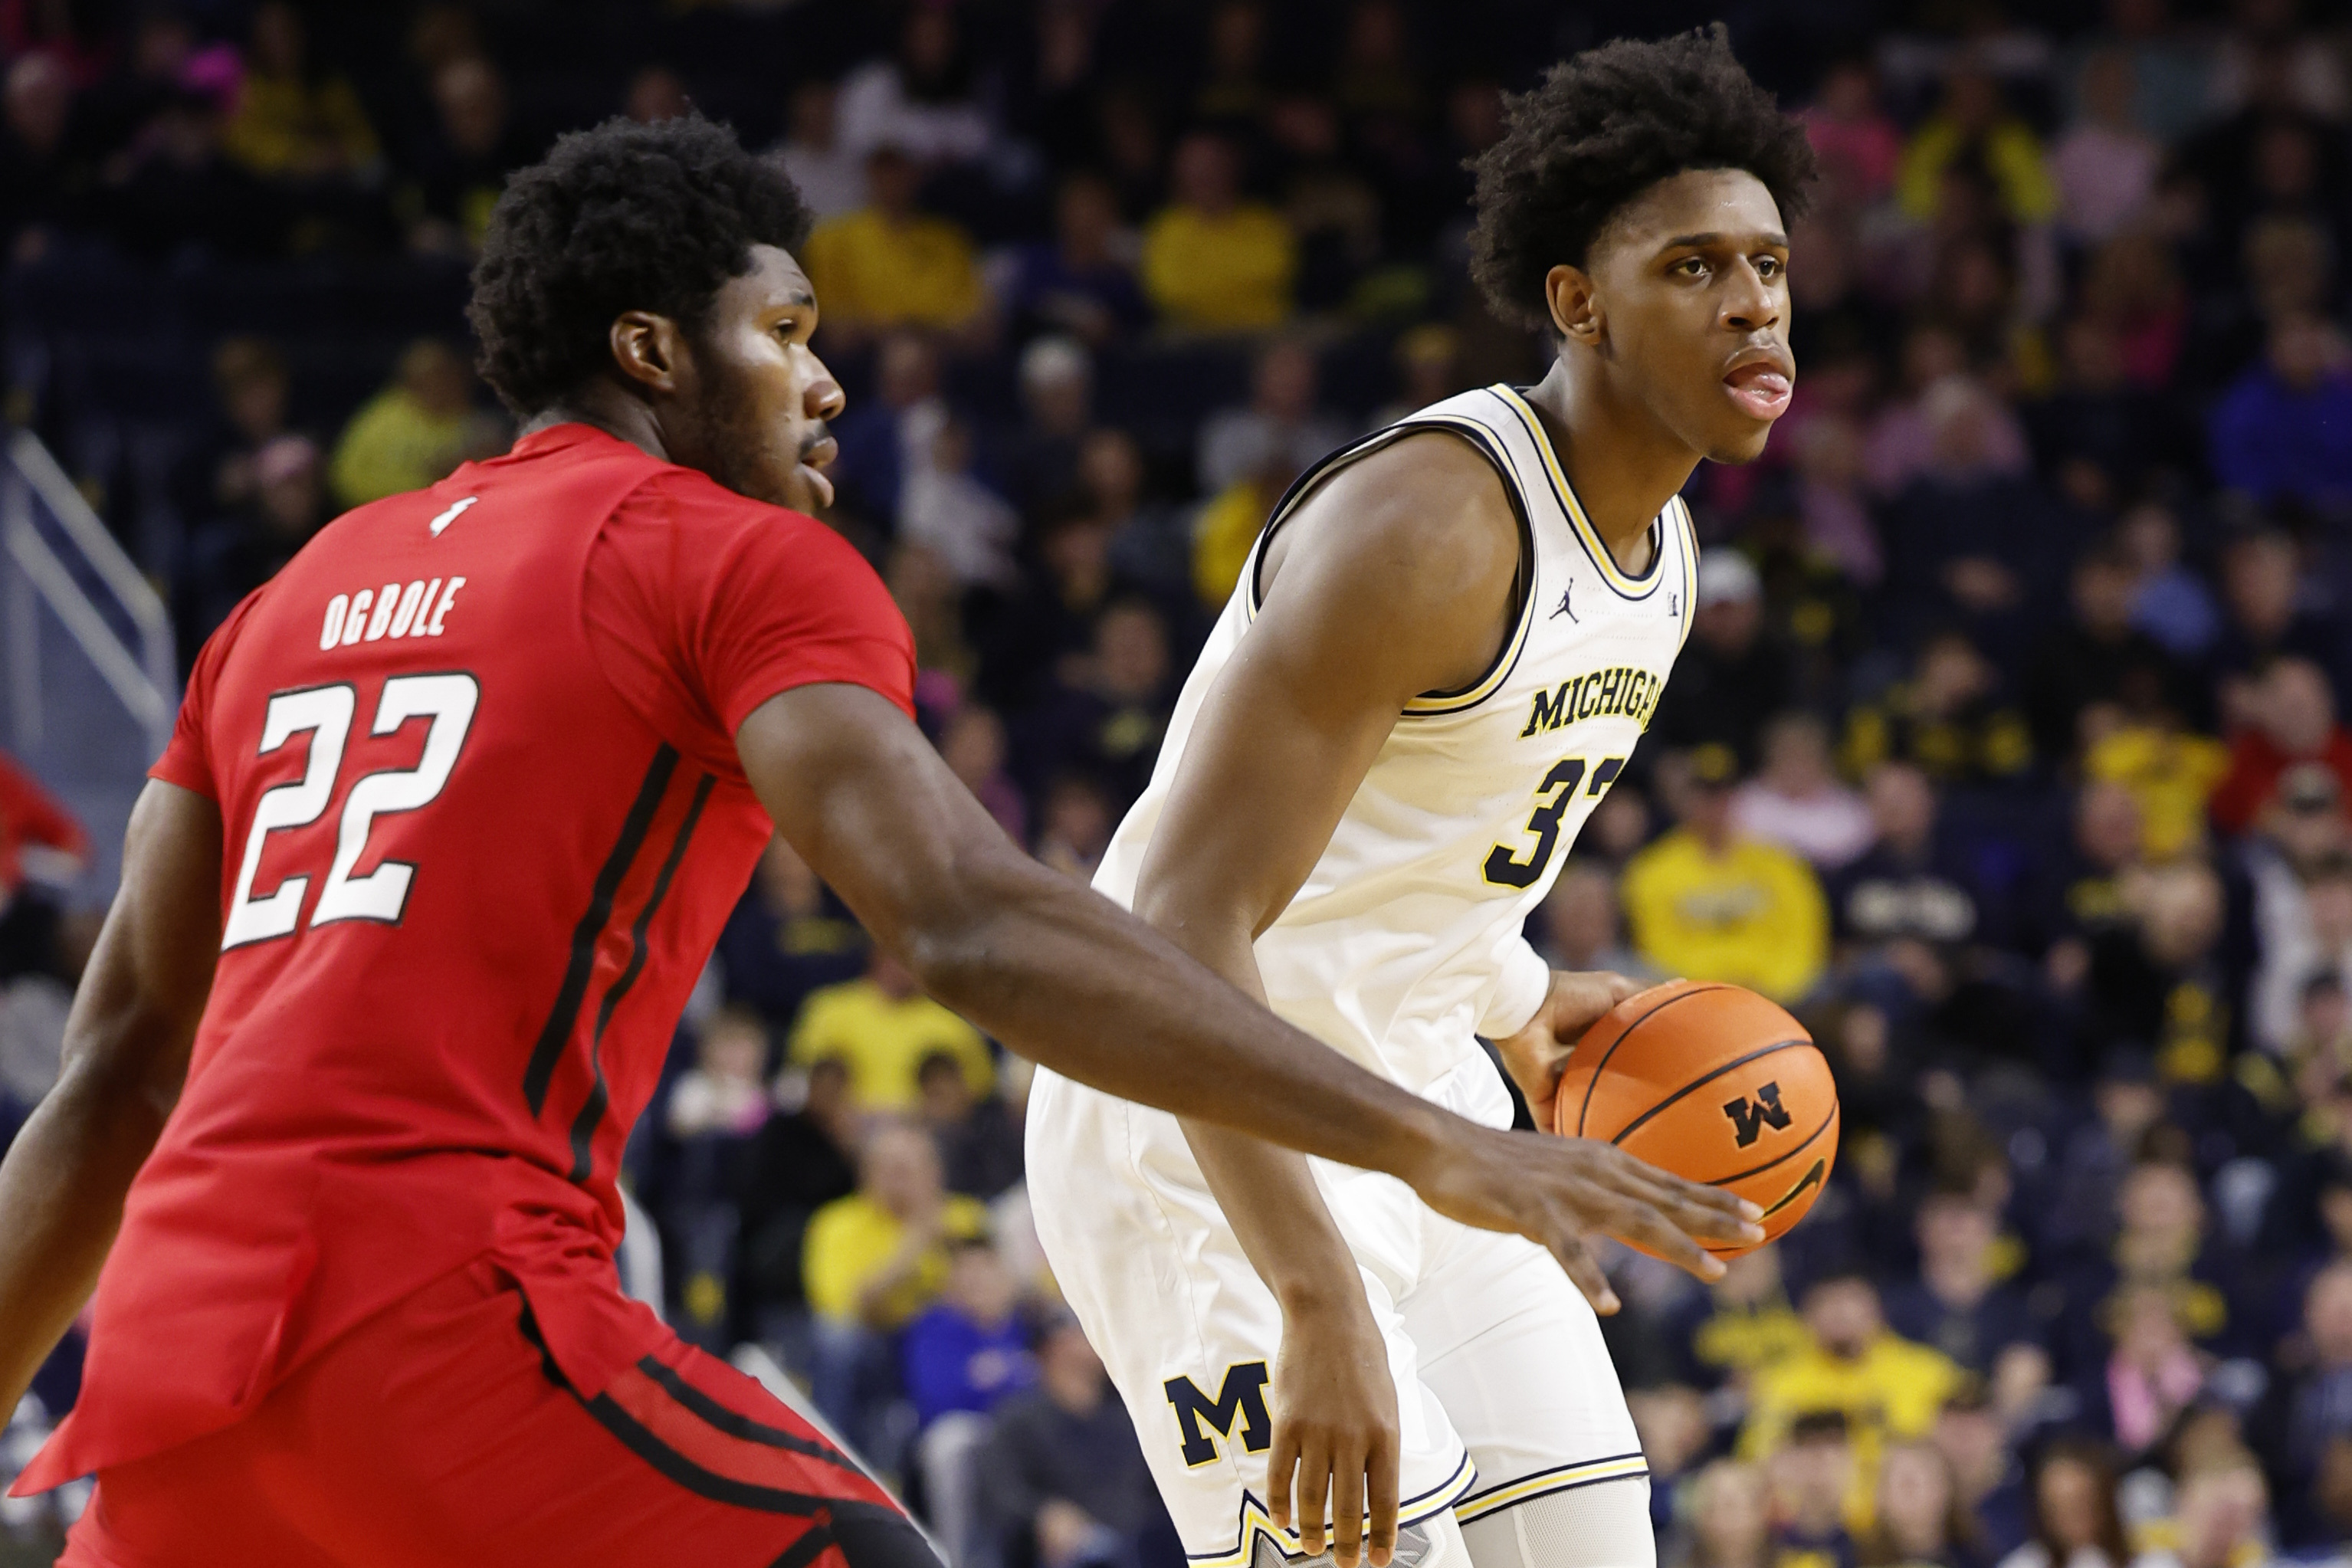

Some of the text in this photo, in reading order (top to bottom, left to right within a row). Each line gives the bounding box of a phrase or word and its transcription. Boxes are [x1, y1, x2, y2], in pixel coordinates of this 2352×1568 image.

[320, 576, 467, 651] OGBOLE
[1517, 666, 1661, 741] MICHIGA
[219, 670, 481, 953] 22
[1163, 1359, 1272, 1468] M
